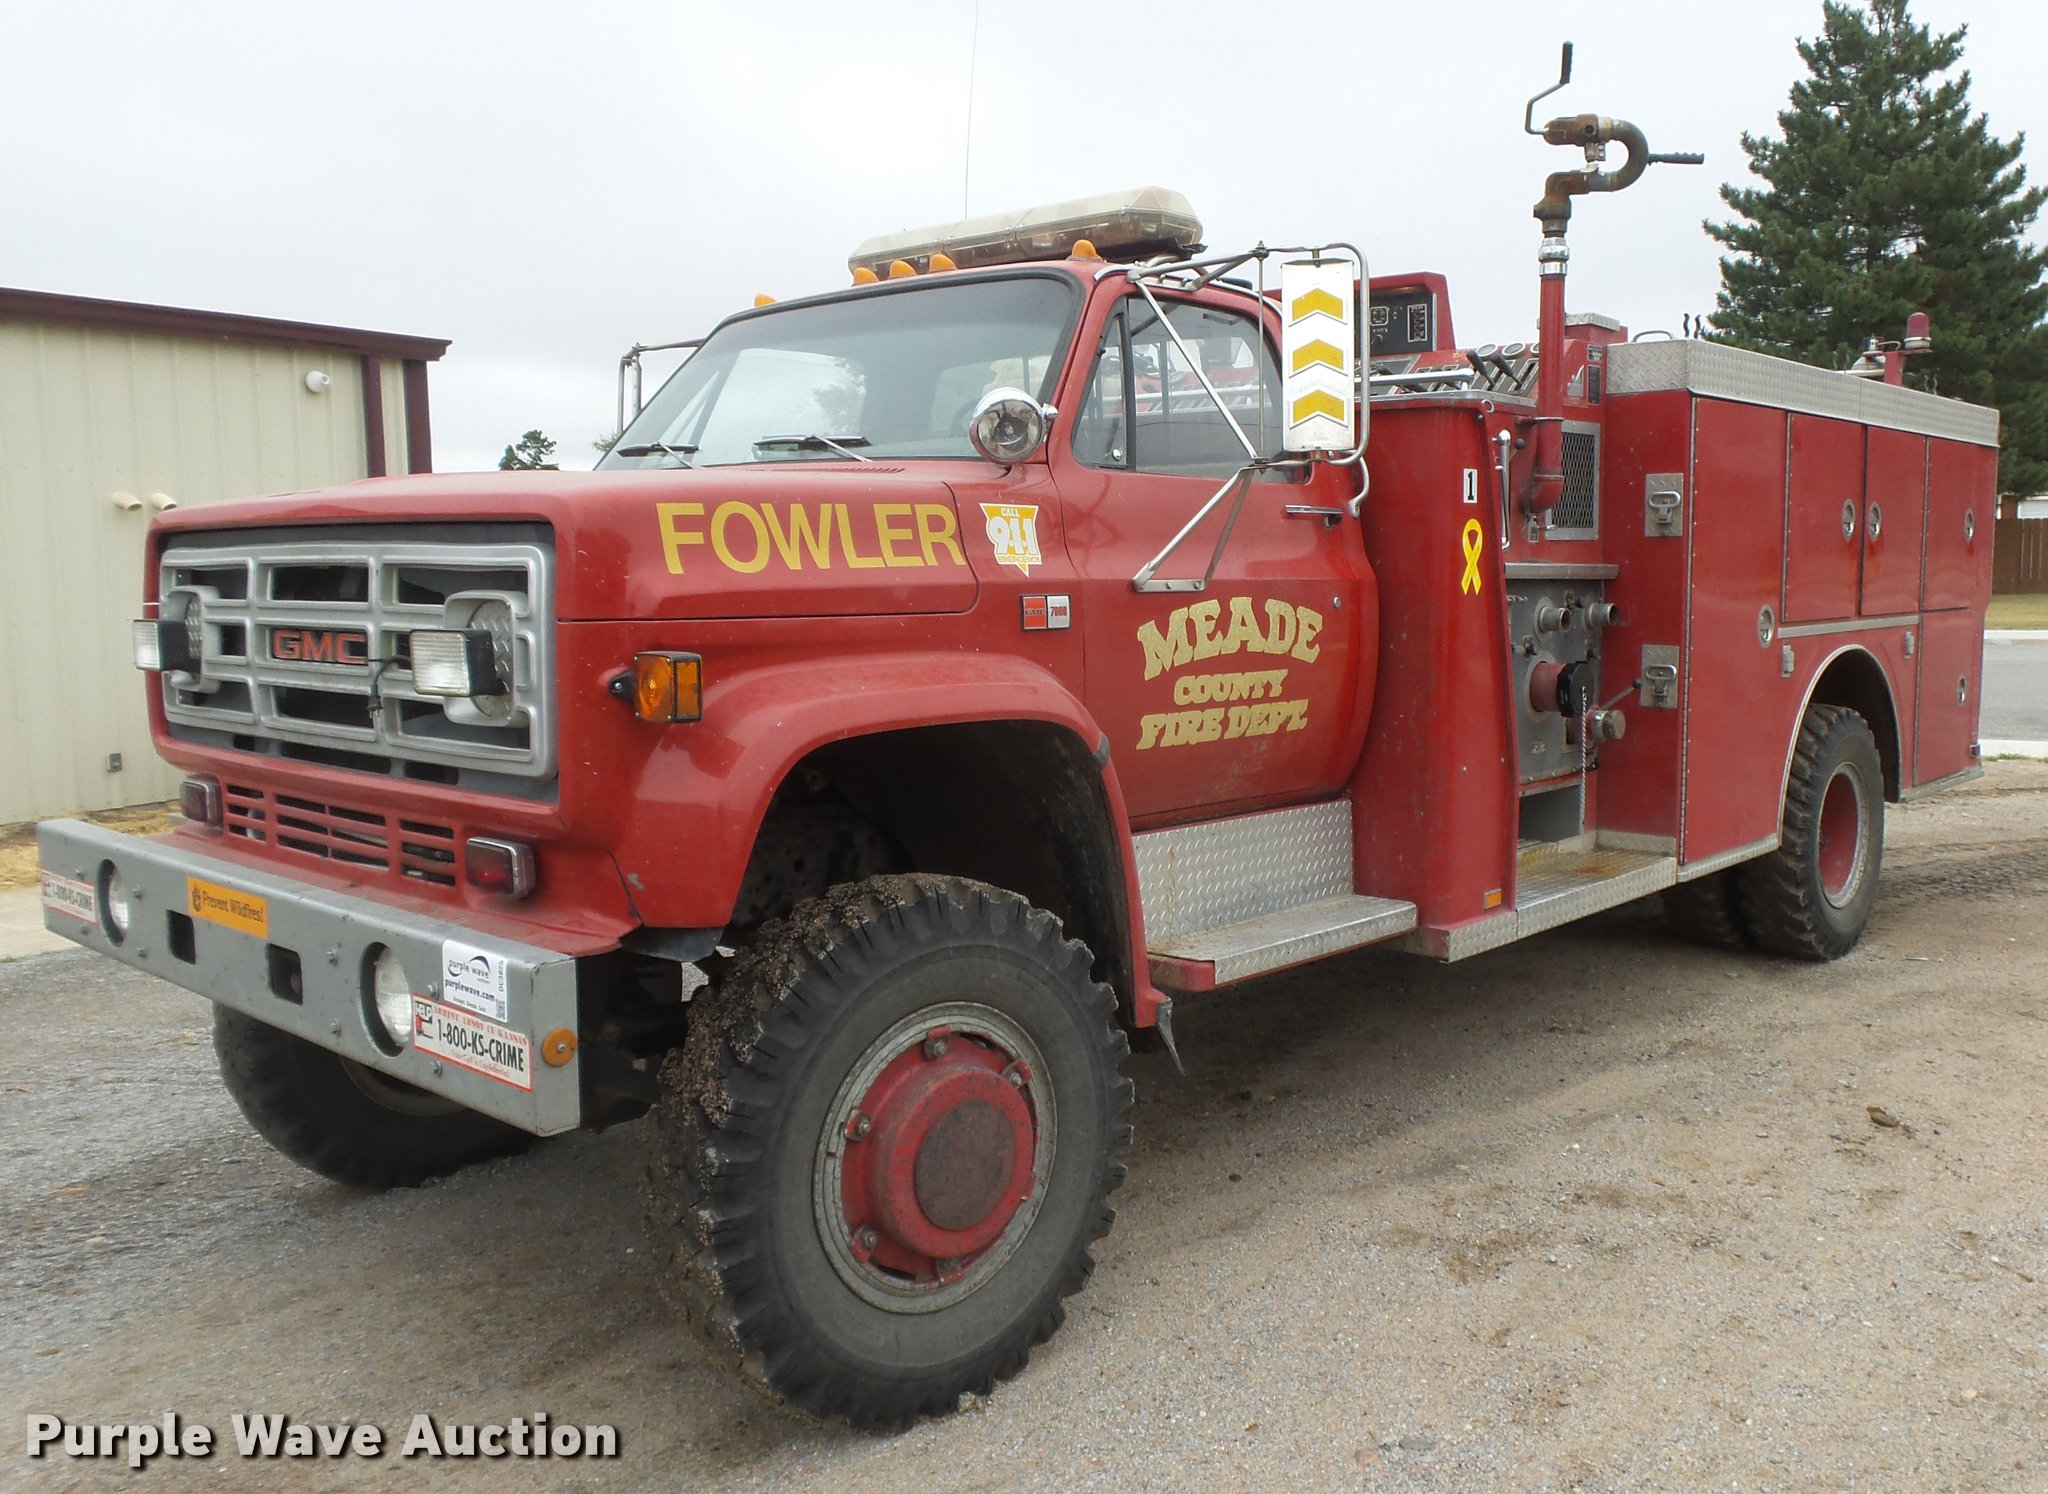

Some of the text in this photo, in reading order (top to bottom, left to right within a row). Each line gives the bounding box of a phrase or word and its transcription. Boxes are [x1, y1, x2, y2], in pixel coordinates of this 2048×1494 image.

[1467, 471, 1475, 500] 1
[1001, 508, 1020, 517] CALL
[656, 501, 967, 575] FOWLER
[273, 630, 368, 665] GMC
[1137, 597, 1323, 681] MEADE
[1174, 669, 1288, 706] COUNTY
[1136, 708, 1225, 750] FIRE
[203, 890, 229, 912] Prevent
[449, 959, 489, 979] purple wave
[445, 979, 495, 1002] purplewave.com
[438, 1019, 524, 1072] 1-800-KS-CRIME
